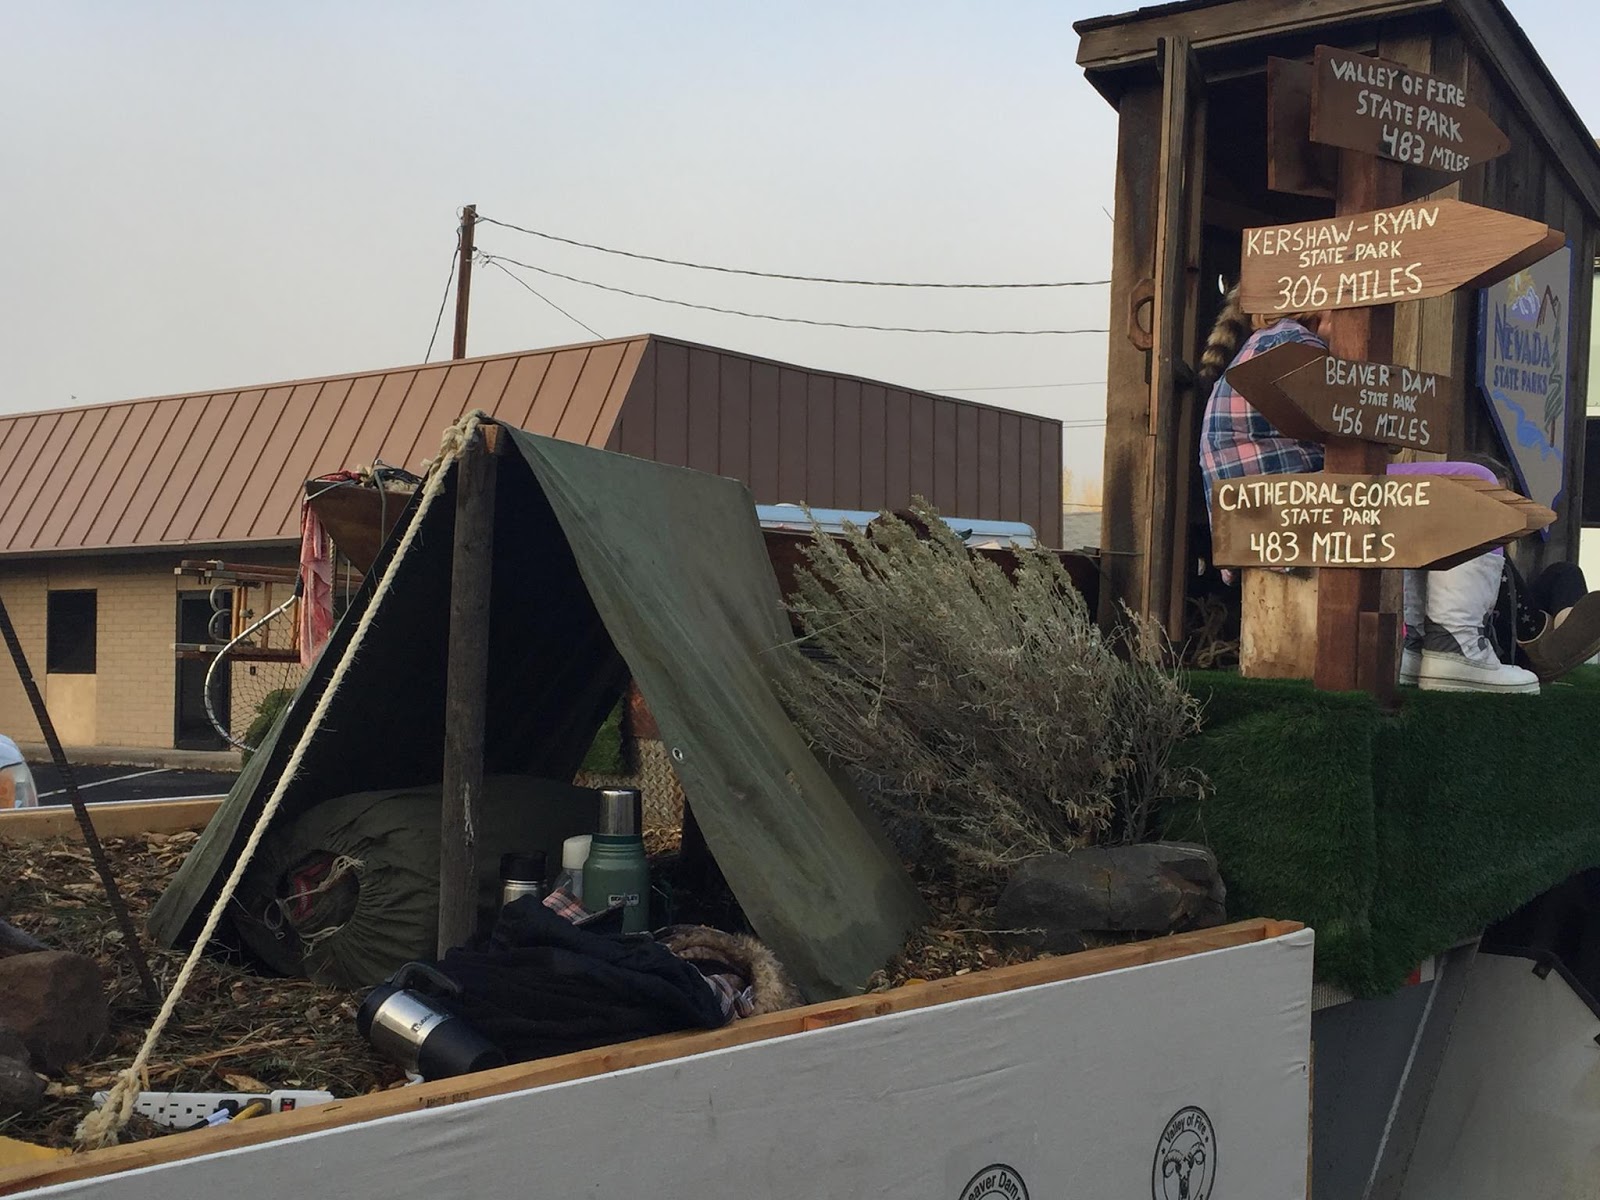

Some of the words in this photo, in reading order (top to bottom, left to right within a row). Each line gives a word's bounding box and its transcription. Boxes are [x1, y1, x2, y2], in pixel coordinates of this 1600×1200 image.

[1330, 58, 1399, 90] VALLEY
[1402, 74, 1423, 96] OF
[1426, 78, 1466, 107] FIRE
[1356, 89, 1413, 125] STATE
[1416, 105, 1463, 143] PARK
[1382, 124, 1425, 164] 483
[1429, 145, 1470, 172] MILES
[1299, 246, 1348, 268] STATE
[1355, 240, 1402, 262] PARK
[1274, 274, 1328, 310] 306
[1336, 262, 1423, 305] MILES
[1494, 301, 1551, 368] NEVADA
[1326, 356, 1390, 387] BEAVER
[1402, 368, 1436, 397] DAM
[1494, 365, 1519, 391] STATE
[1521, 370, 1548, 395] PARKS
[1360, 389, 1389, 406] STATE
[1393, 393, 1417, 413] PARK
[1332, 404, 1362, 435] 456
[1375, 413, 1430, 445] MILES
[1218, 481, 1343, 511] CATHEDRAL
[1350, 480, 1430, 507] GORGE
[1280, 508, 1333, 527] STATE
[1343, 507, 1381, 526] PARK
[1250, 531, 1299, 563] 483
[1312, 531, 1396, 564] MILES
[1165, 1117, 1185, 1143] Valley
[1187, 1113, 1195, 1126] of
[1194, 1115, 1206, 1135] Fire
[968, 1175, 996, 1200] eaver
[998, 1171, 1018, 1199] Dam
